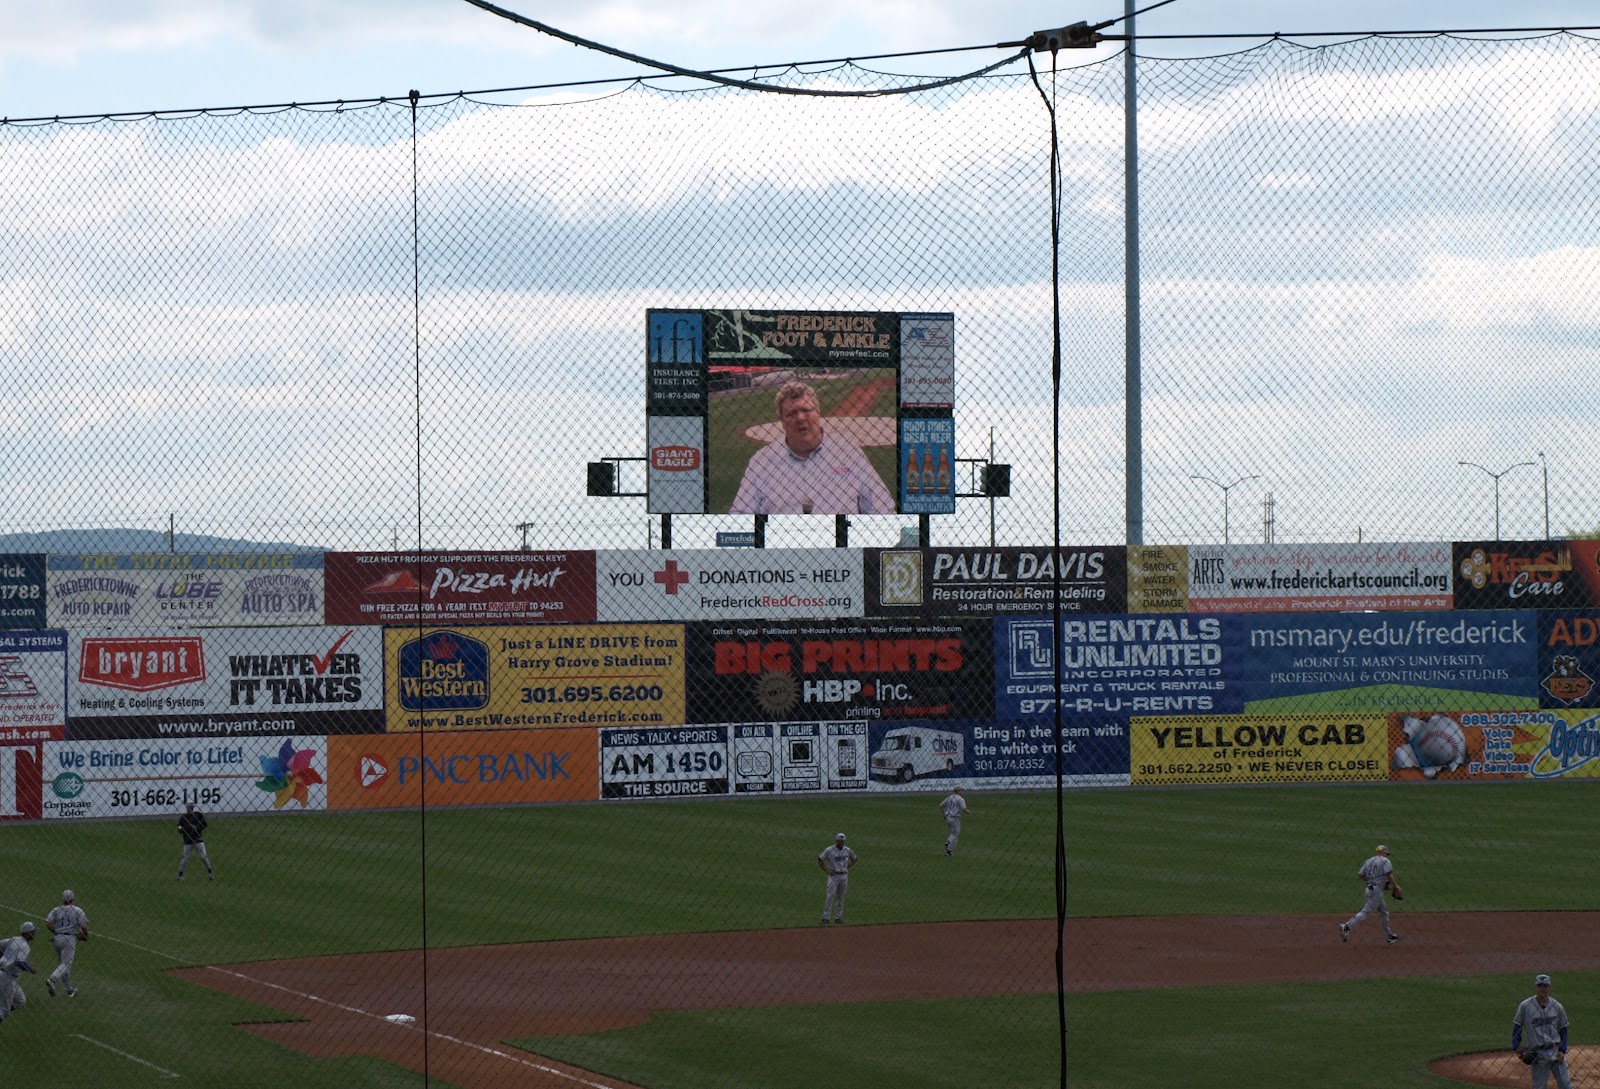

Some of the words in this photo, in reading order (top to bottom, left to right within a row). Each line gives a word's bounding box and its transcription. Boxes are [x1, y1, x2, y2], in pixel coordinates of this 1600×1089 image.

[776, 314, 876, 332] FREDERICK
[762, 332, 808, 348] FOOT
[831, 333, 891, 349] ANKLE
[653, 369, 700, 377] INSURANCE
[903, 421, 926, 432] GOOD
[928, 421, 952, 432] TIMES
[903, 432, 929, 444] GREAT
[931, 432, 952, 444] BEER
[656, 449, 695, 458] GIANT
[657, 458, 694, 467] EAGLE
[356, 555, 380, 563] PIZZA
[381, 555, 399, 563] HUT
[400, 555, 438, 563] PROUDLY
[440, 555, 482, 563] SUPPORTS
[500, 554, 545, 562] FREDERICK
[546, 554, 567, 562] KEYS
[1142, 550, 1164, 559] FIRE
[932, 553, 1008, 580] PAUL
[1016, 552, 1105, 580] DAVIS
[1142, 562, 1178, 571] SMOKE
[1193, 558, 1225, 585] ARTS
[185, 573, 204, 581] THE
[429, 567, 506, 599] Pizza
[510, 566, 567, 595] Hut
[609, 572, 644, 587] YOU
[699, 569, 795, 585] DONATIONS
[813, 569, 851, 583] HELP
[1143, 576, 1175, 584] WATER
[1230, 567, 1448, 591] www.frederickartscouncil.org
[53, 577, 140, 599] FREDERICKTOWNE
[155, 580, 224, 599] LUBE
[1509, 571, 1564, 599] Care
[1143, 588, 1177, 597] STORM
[62, 602, 90, 615] AUTO
[93, 602, 131, 615] REPAIR
[161, 601, 214, 610] CENTER
[241, 594, 283, 613] AUTO
[288, 594, 318, 613] SPA
[360, 604, 375, 612] WIN
[376, 604, 395, 612] FREE
[397, 603, 419, 612] PIZZA
[420, 603, 435, 611] FOR
[445, 603, 467, 611] YEAR!
[469, 602, 487, 611] TEXT
[488, 601, 528, 611] MYHUT
[529, 602, 538, 610] TO
[701, 595, 852, 609] FrederickRedCross.org
[957, 603, 969, 611] 24
[971, 603, 993, 611] HOUR
[996, 602, 1044, 610] EMERGENCY
[1142, 600, 1184, 608] DAMAGE
[1291, 599, 1342, 609] Frederick
[1346, 598, 1387, 608] Festival
[1404, 599, 1420, 607] the
[1423, 598, 1447, 607] Arts
[1064, 618, 1221, 643] RENTALS
[1251, 619, 1527, 653] msmary.edu/frederick
[18, 636, 63, 646] SYSTEMS
[500, 637, 532, 652] Just
[535, 640, 543, 649] a
[547, 637, 585, 649] LINE
[590, 636, 640, 649] DRIVE
[644, 635, 678, 648] from
[714, 641, 792, 675] BIG
[802, 639, 963, 673] PRINTS
[1064, 643, 1222, 668] UNLIMITED
[1293, 656, 1340, 668] MOUNT
[1361, 656, 1405, 667] MARY'S
[1409, 655, 1485, 666] UNIVERSITY
[98, 647, 188, 679] bryant
[420, 659, 466, 680] Best
[508, 657, 550, 671] Harry
[555, 656, 599, 668] Grove
[603, 655, 673, 667] Stadium!
[1064, 668, 1222, 679] INCORPORATED
[1270, 671, 1355, 683] PROFESSIONAL
[1373, 670, 1455, 682] CONTINUING
[1459, 669, 1509, 681] STUDIES
[230, 679, 261, 706] IT
[266, 676, 362, 705] TAKES
[401, 676, 486, 699] Western
[803, 679, 862, 702] HBP
[876, 678, 913, 701] Inc.
[1108, 682, 1157, 692] TRUCK
[1161, 681, 1225, 691] RENTALS
[520, 685, 663, 703] 301.695.6200
[80, 698, 115, 710] Heating
[129, 697, 163, 709] Cooling
[166, 697, 205, 708] Systems
[13, 714, 55, 722] OPERATED
[845, 706, 881, 718] printing
[158, 718, 296, 735] www.bryant.com
[407, 711, 663, 728] www.BestWesternFrederick.com
[1461, 713, 1555, 726] 888.302.7400
[742, 727, 752, 737] ON
[754, 726, 766, 736] AIR
[787, 725, 813, 736] ONLINE
[828, 725, 838, 735] ON
[840, 724, 854, 734] THE
[973, 726, 1010, 742] Bring
[1014, 726, 1026, 738] in
[1030, 725, 1052, 738] the
[1093, 724, 1123, 736] with
[1150, 725, 1287, 748] YELLOW
[1299, 724, 1366, 745] CAB
[1484, 728, 1513, 738] Voice
[610, 733, 639, 745] NEWS
[649, 732, 671, 743] TALK
[679, 730, 718, 742] SPORTS
[1486, 740, 1512, 749] Data
[973, 743, 997, 756] the
[1000, 741, 1038, 755] white
[1213, 748, 1228, 759] of
[1232, 747, 1302, 758] Frederick
[59, 751, 85, 768] We
[90, 750, 133, 767] Bring
[138, 749, 183, 766] Color
[186, 750, 203, 765] to
[207, 747, 244, 764] Life!
[610, 754, 654, 775] AM
[665, 751, 722, 774] 1450
[1484, 752, 1514, 761] Video
[396, 755, 470, 785] PNC
[477, 752, 571, 782] BANK
[974, 759, 1045, 771] 301.874.8352
[1139, 763, 1231, 775] 301.662.2250
[1249, 762, 1271, 772] WE
[1275, 761, 1323, 771] NEVER
[1327, 760, 1379, 771] CLOSE!
[1469, 763, 1481, 773] IT
[1483, 763, 1530, 773] Services
[624, 783, 652, 796] THE
[654, 781, 708, 794] SOURCE
[111, 788, 221, 807] 301-662-1195
[44, 801, 91, 811] Corporate
